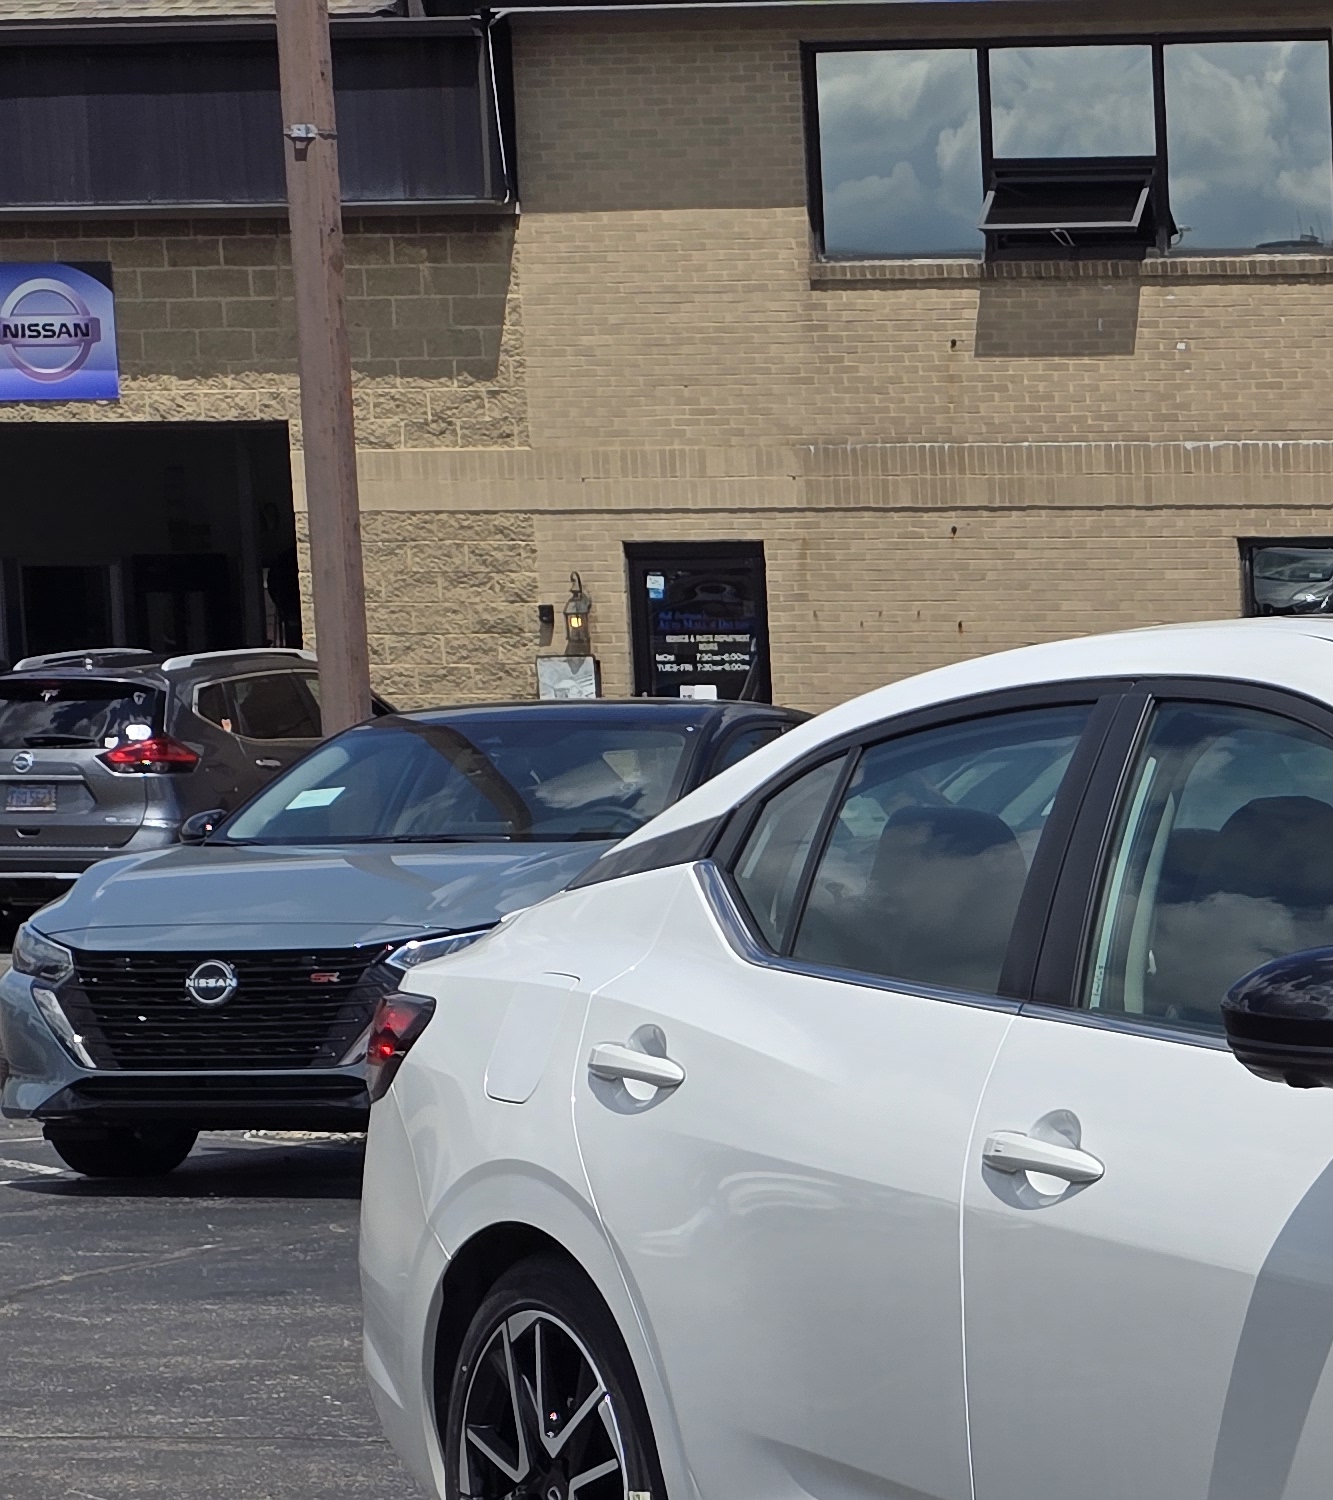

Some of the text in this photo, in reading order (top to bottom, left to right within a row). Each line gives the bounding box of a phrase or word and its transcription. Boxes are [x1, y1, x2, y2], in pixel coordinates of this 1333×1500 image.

[2, 322, 91, 339] NISSAN
[185, 978, 238, 988] NISSAN
[310, 972, 341, 983] SR
